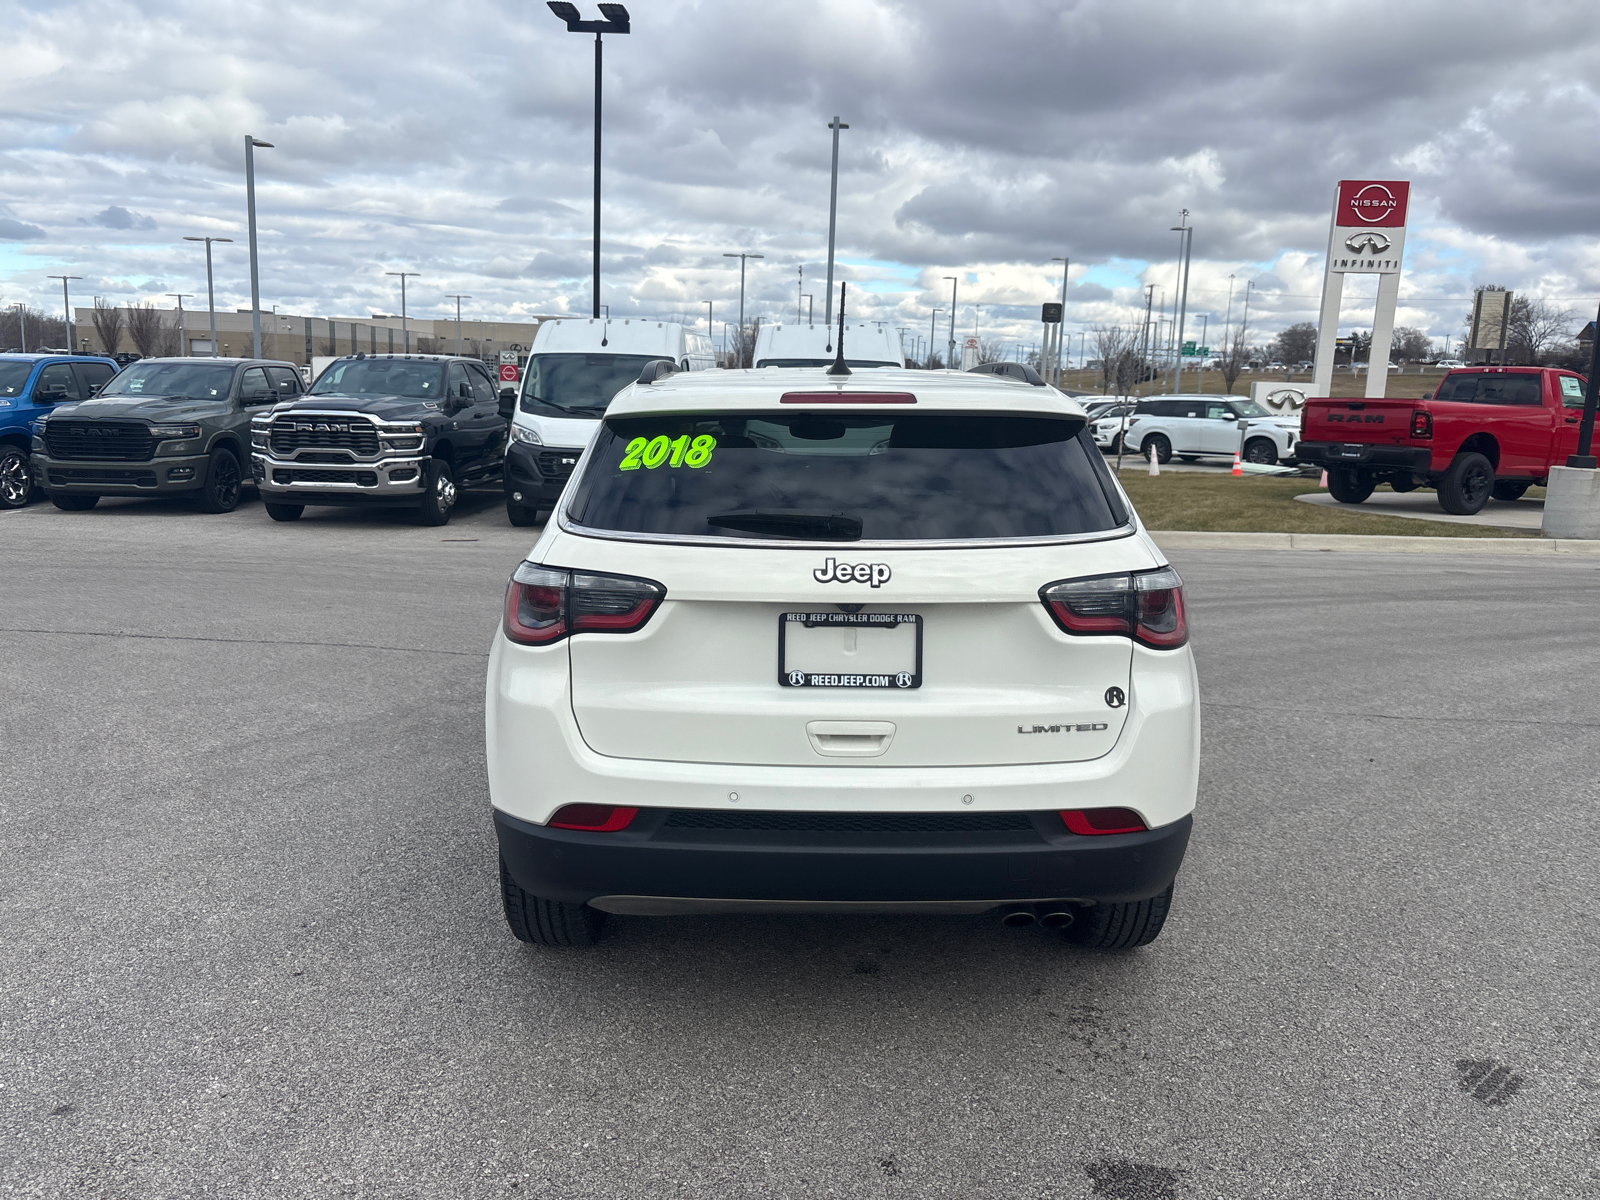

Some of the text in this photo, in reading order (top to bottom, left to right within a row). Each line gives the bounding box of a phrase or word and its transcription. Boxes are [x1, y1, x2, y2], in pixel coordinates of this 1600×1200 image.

[1350, 199, 1397, 207] NISSAN
[1333, 259, 1398, 269] INFINITI
[1326, 414, 1385, 423] RAM
[69, 428, 120, 436] RAM
[297, 423, 348, 432] RAM
[619, 434, 717, 471] 2018
[813, 557, 891, 588] Jeep
[786, 613, 916, 623] REED JEEP CHRYSLER DODGE RAM
[811, 675, 889, 687] REEDJEEP.COM
[1017, 721, 1108, 734] LIMITED
